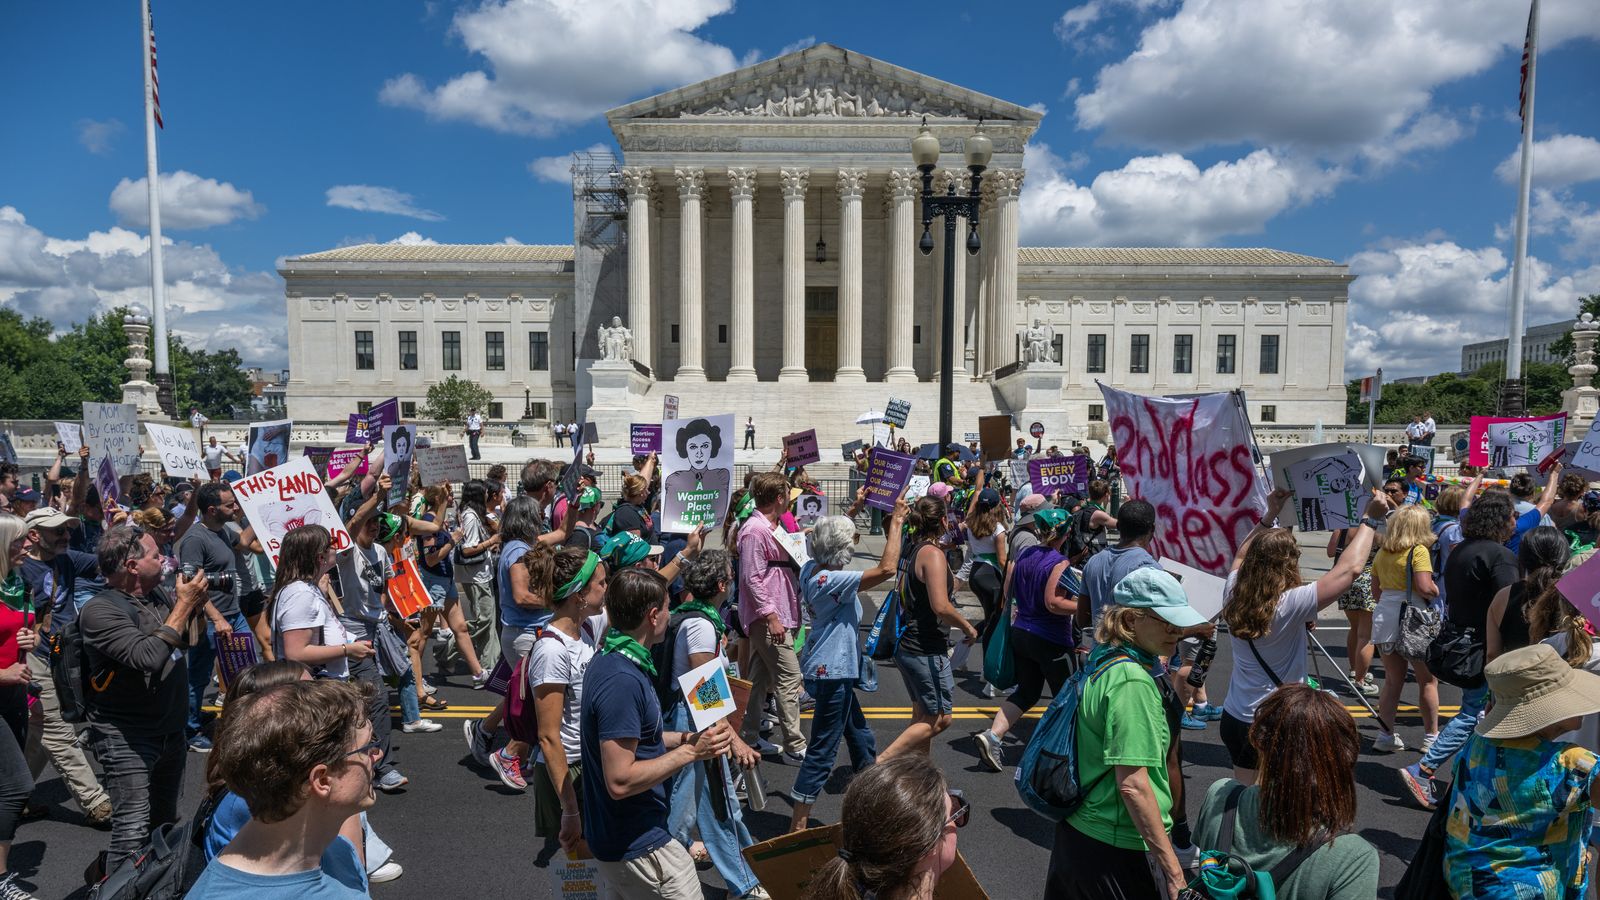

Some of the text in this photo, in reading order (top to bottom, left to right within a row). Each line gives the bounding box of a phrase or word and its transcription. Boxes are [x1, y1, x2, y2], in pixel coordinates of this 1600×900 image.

[100, 405, 120, 419] MOM
[104, 422, 136, 434] CHOICE
[104, 437, 124, 449] MOM
[787, 434, 812, 446] ABORTION
[166, 452, 184, 468] GO
[786, 452, 818, 463] HEALTHCARE
[874, 459, 886, 467] OUR
[1040, 465, 1075, 476] EVERY
[233, 470, 322, 502] THIS LAND
[696, 482, 703, 490] A
[1042, 474, 1075, 486] BODY
[1320, 473, 1330, 496] The
[677, 490, 719, 501] Woman's
[687, 502, 711, 511] Place
[1348, 490, 1360, 526] Force
[681, 510, 715, 520] is in the
[267, 538, 280, 552] IS
